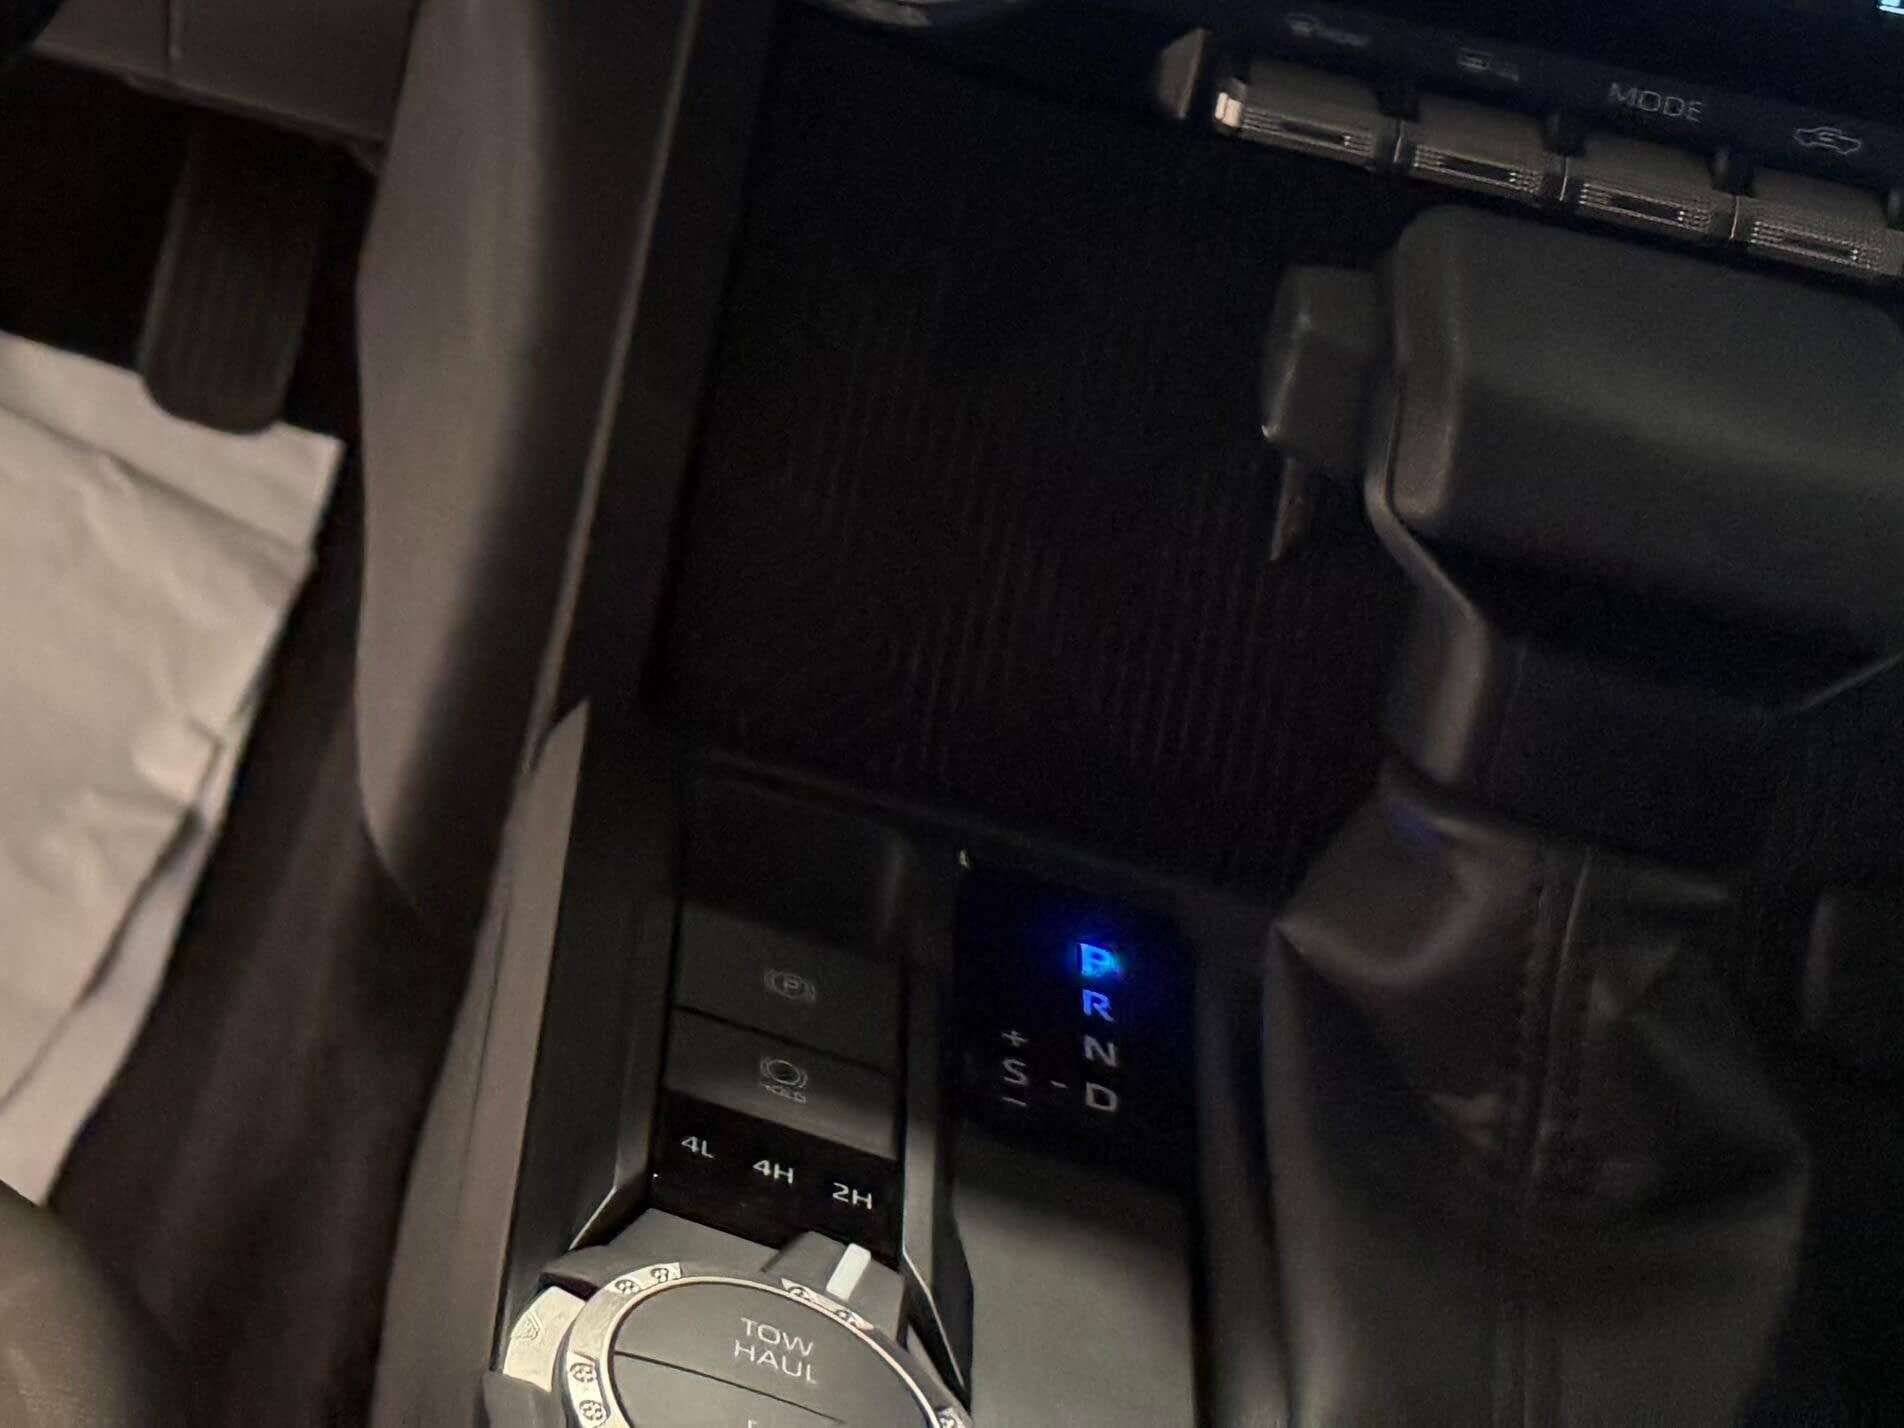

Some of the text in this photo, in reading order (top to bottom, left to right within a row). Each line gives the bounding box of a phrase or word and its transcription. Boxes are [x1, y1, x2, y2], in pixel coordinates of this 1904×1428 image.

[1609, 81, 1703, 122] MODE
[1080, 943, 1118, 978] P
[1082, 989, 1115, 1023] R
[1083, 1033, 1119, 1068] N
[1002, 1057, 1120, 1113] S D
[681, 1135, 873, 1211] 4L 4H 2H
[739, 1316, 814, 1357] TOW
[733, 1338, 817, 1385] HAUL
